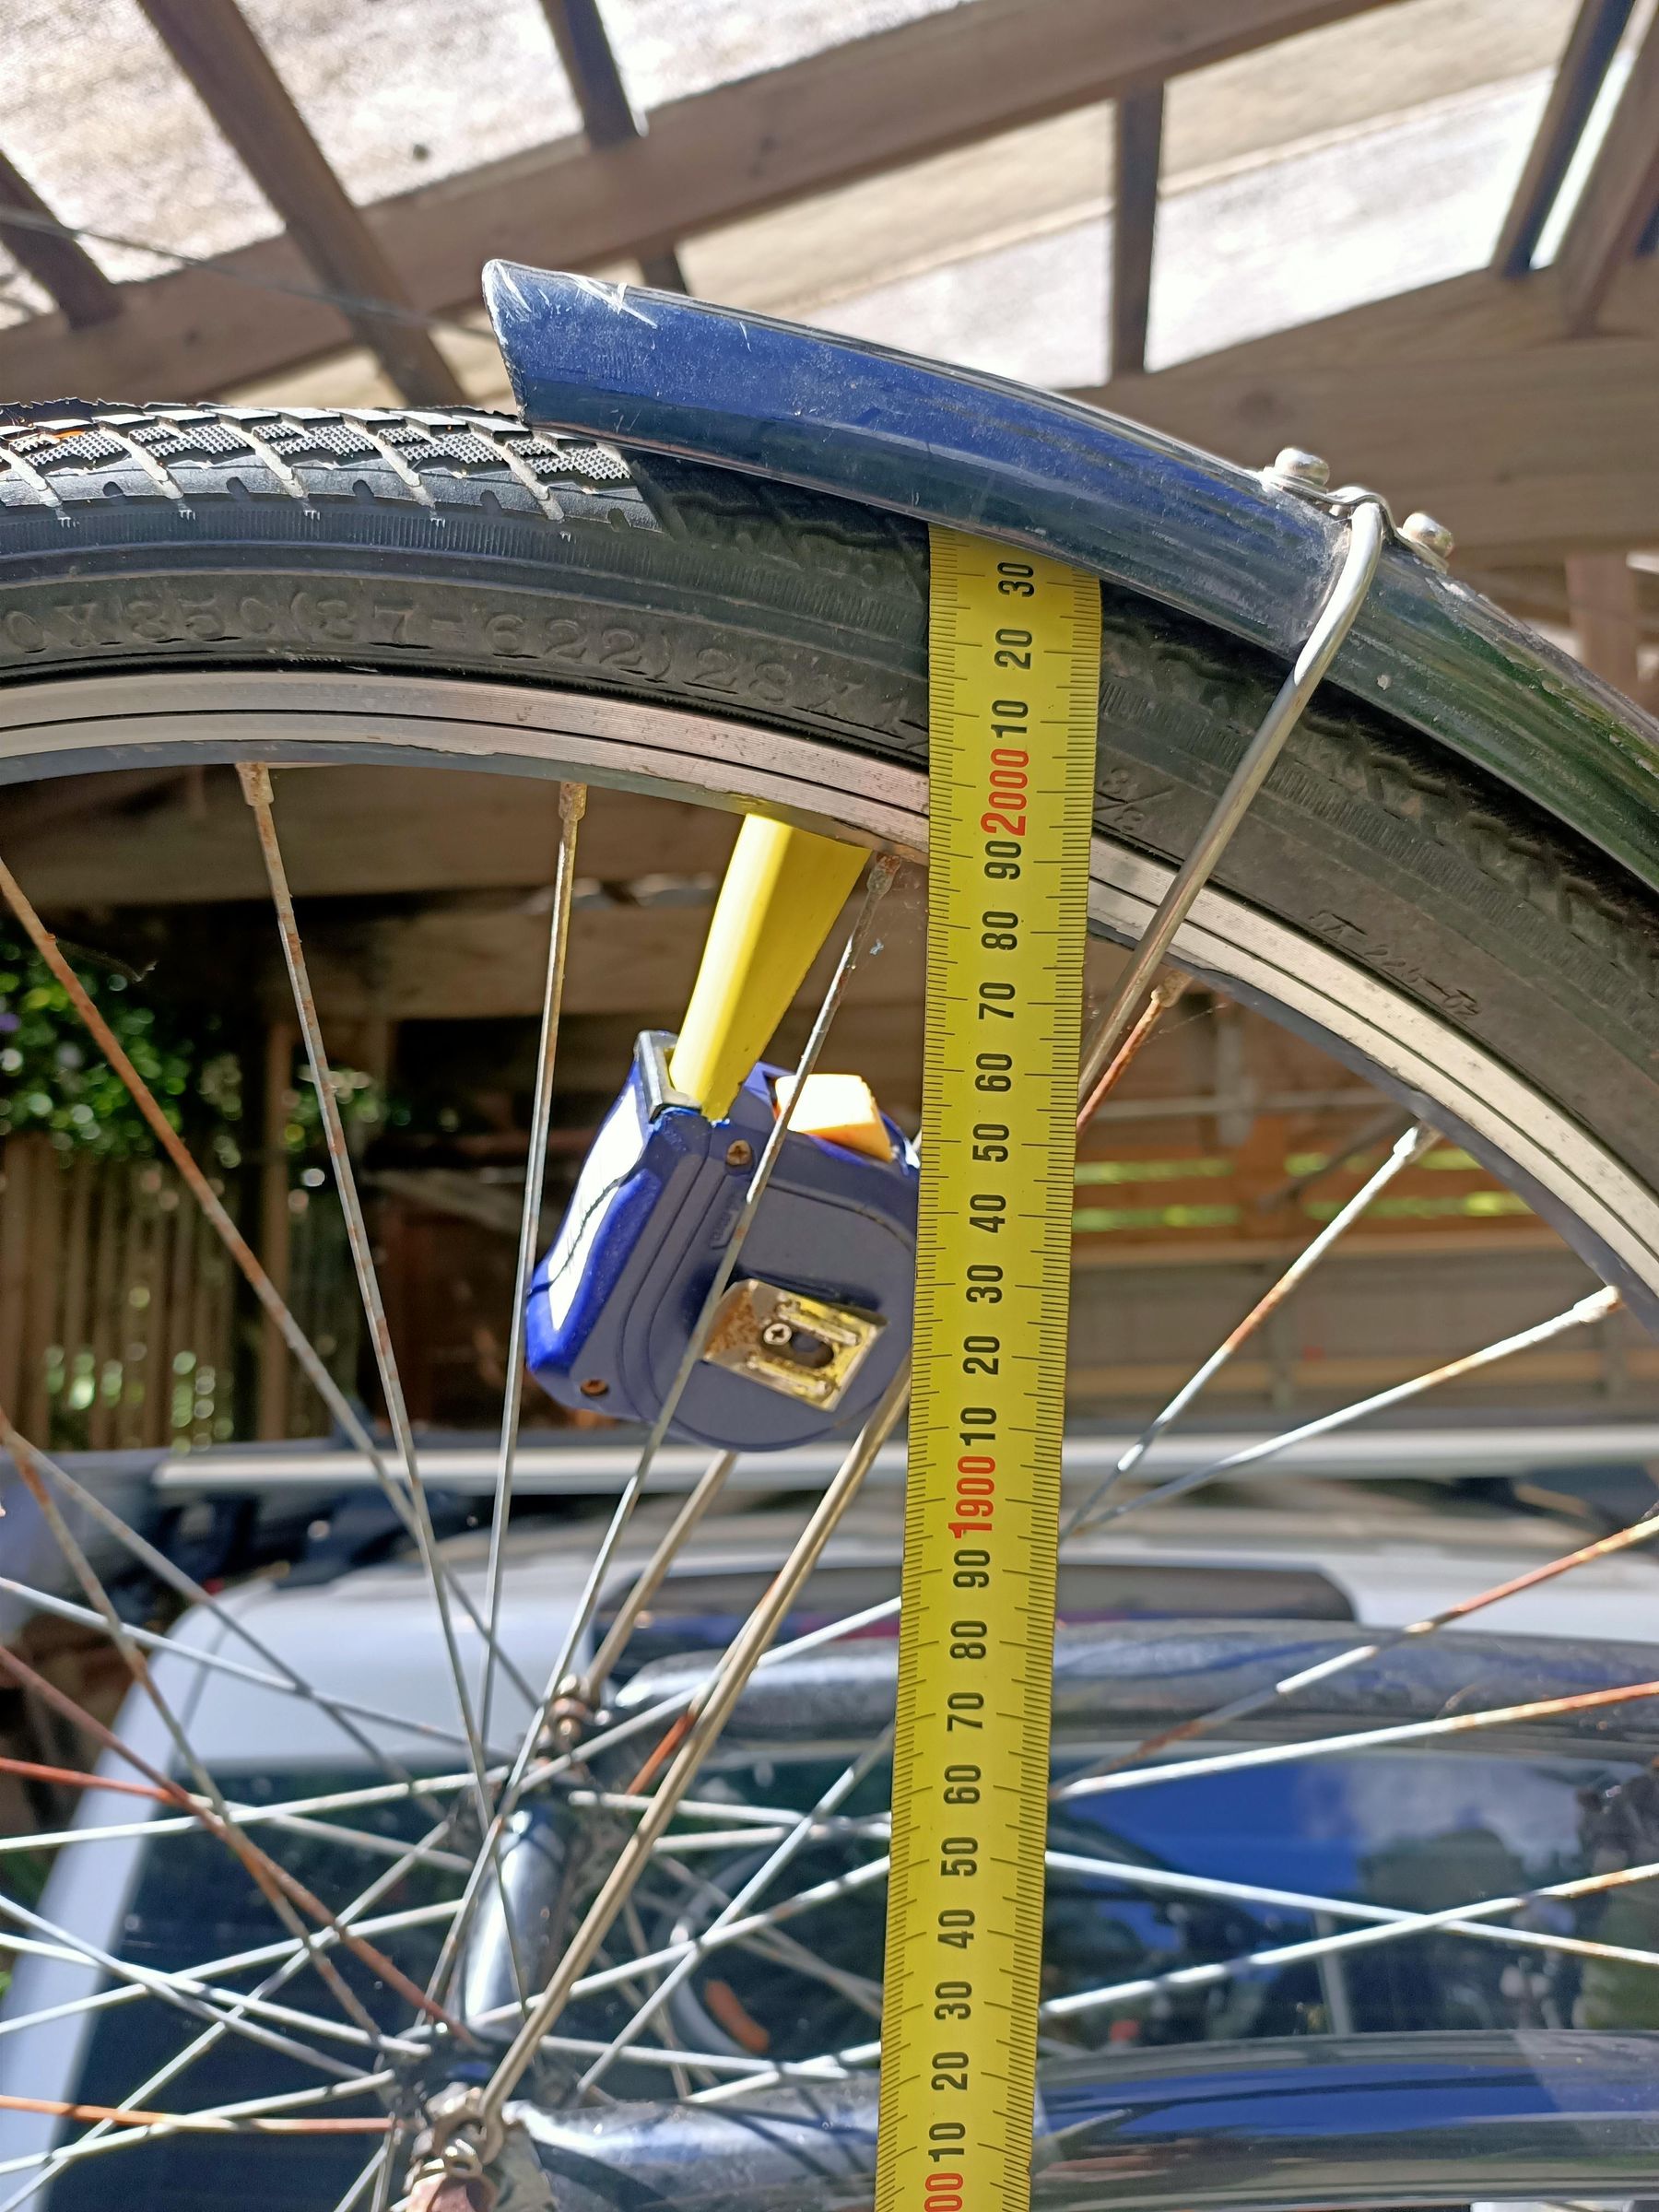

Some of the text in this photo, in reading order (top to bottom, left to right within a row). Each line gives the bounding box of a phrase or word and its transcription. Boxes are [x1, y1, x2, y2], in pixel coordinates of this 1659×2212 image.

[996, 561, 1035, 598] 30
[994, 629, 1033, 670] 20
[991, 700, 1029, 738] 10
[980, 748, 1030, 837] 2000
[983, 841, 1022, 880] 90
[981, 911, 1018, 951] 80
[978, 982, 1016, 1020] 70
[974, 1053, 1013, 1092] 60
[971, 1124, 1010, 1162] 50
[969, 1194, 1006, 1233] 40
[965, 1265, 1004, 1304] 30
[962, 1335, 1000, 1375] 20
[959, 1407, 997, 1446] 10
[947, 1455, 996, 1540] 1900
[952, 1549, 991, 1588] 90
[949, 1620, 988, 1660] 80
[947, 1692, 984, 1732] 70
[943, 1765, 982, 1805] 60
[940, 1838, 978, 1877] 50
[937, 1910, 975, 1949] 40
[934, 1982, 972, 2020] 30
[931, 2052, 969, 2090] 20
[928, 2123, 966, 2163] 10
